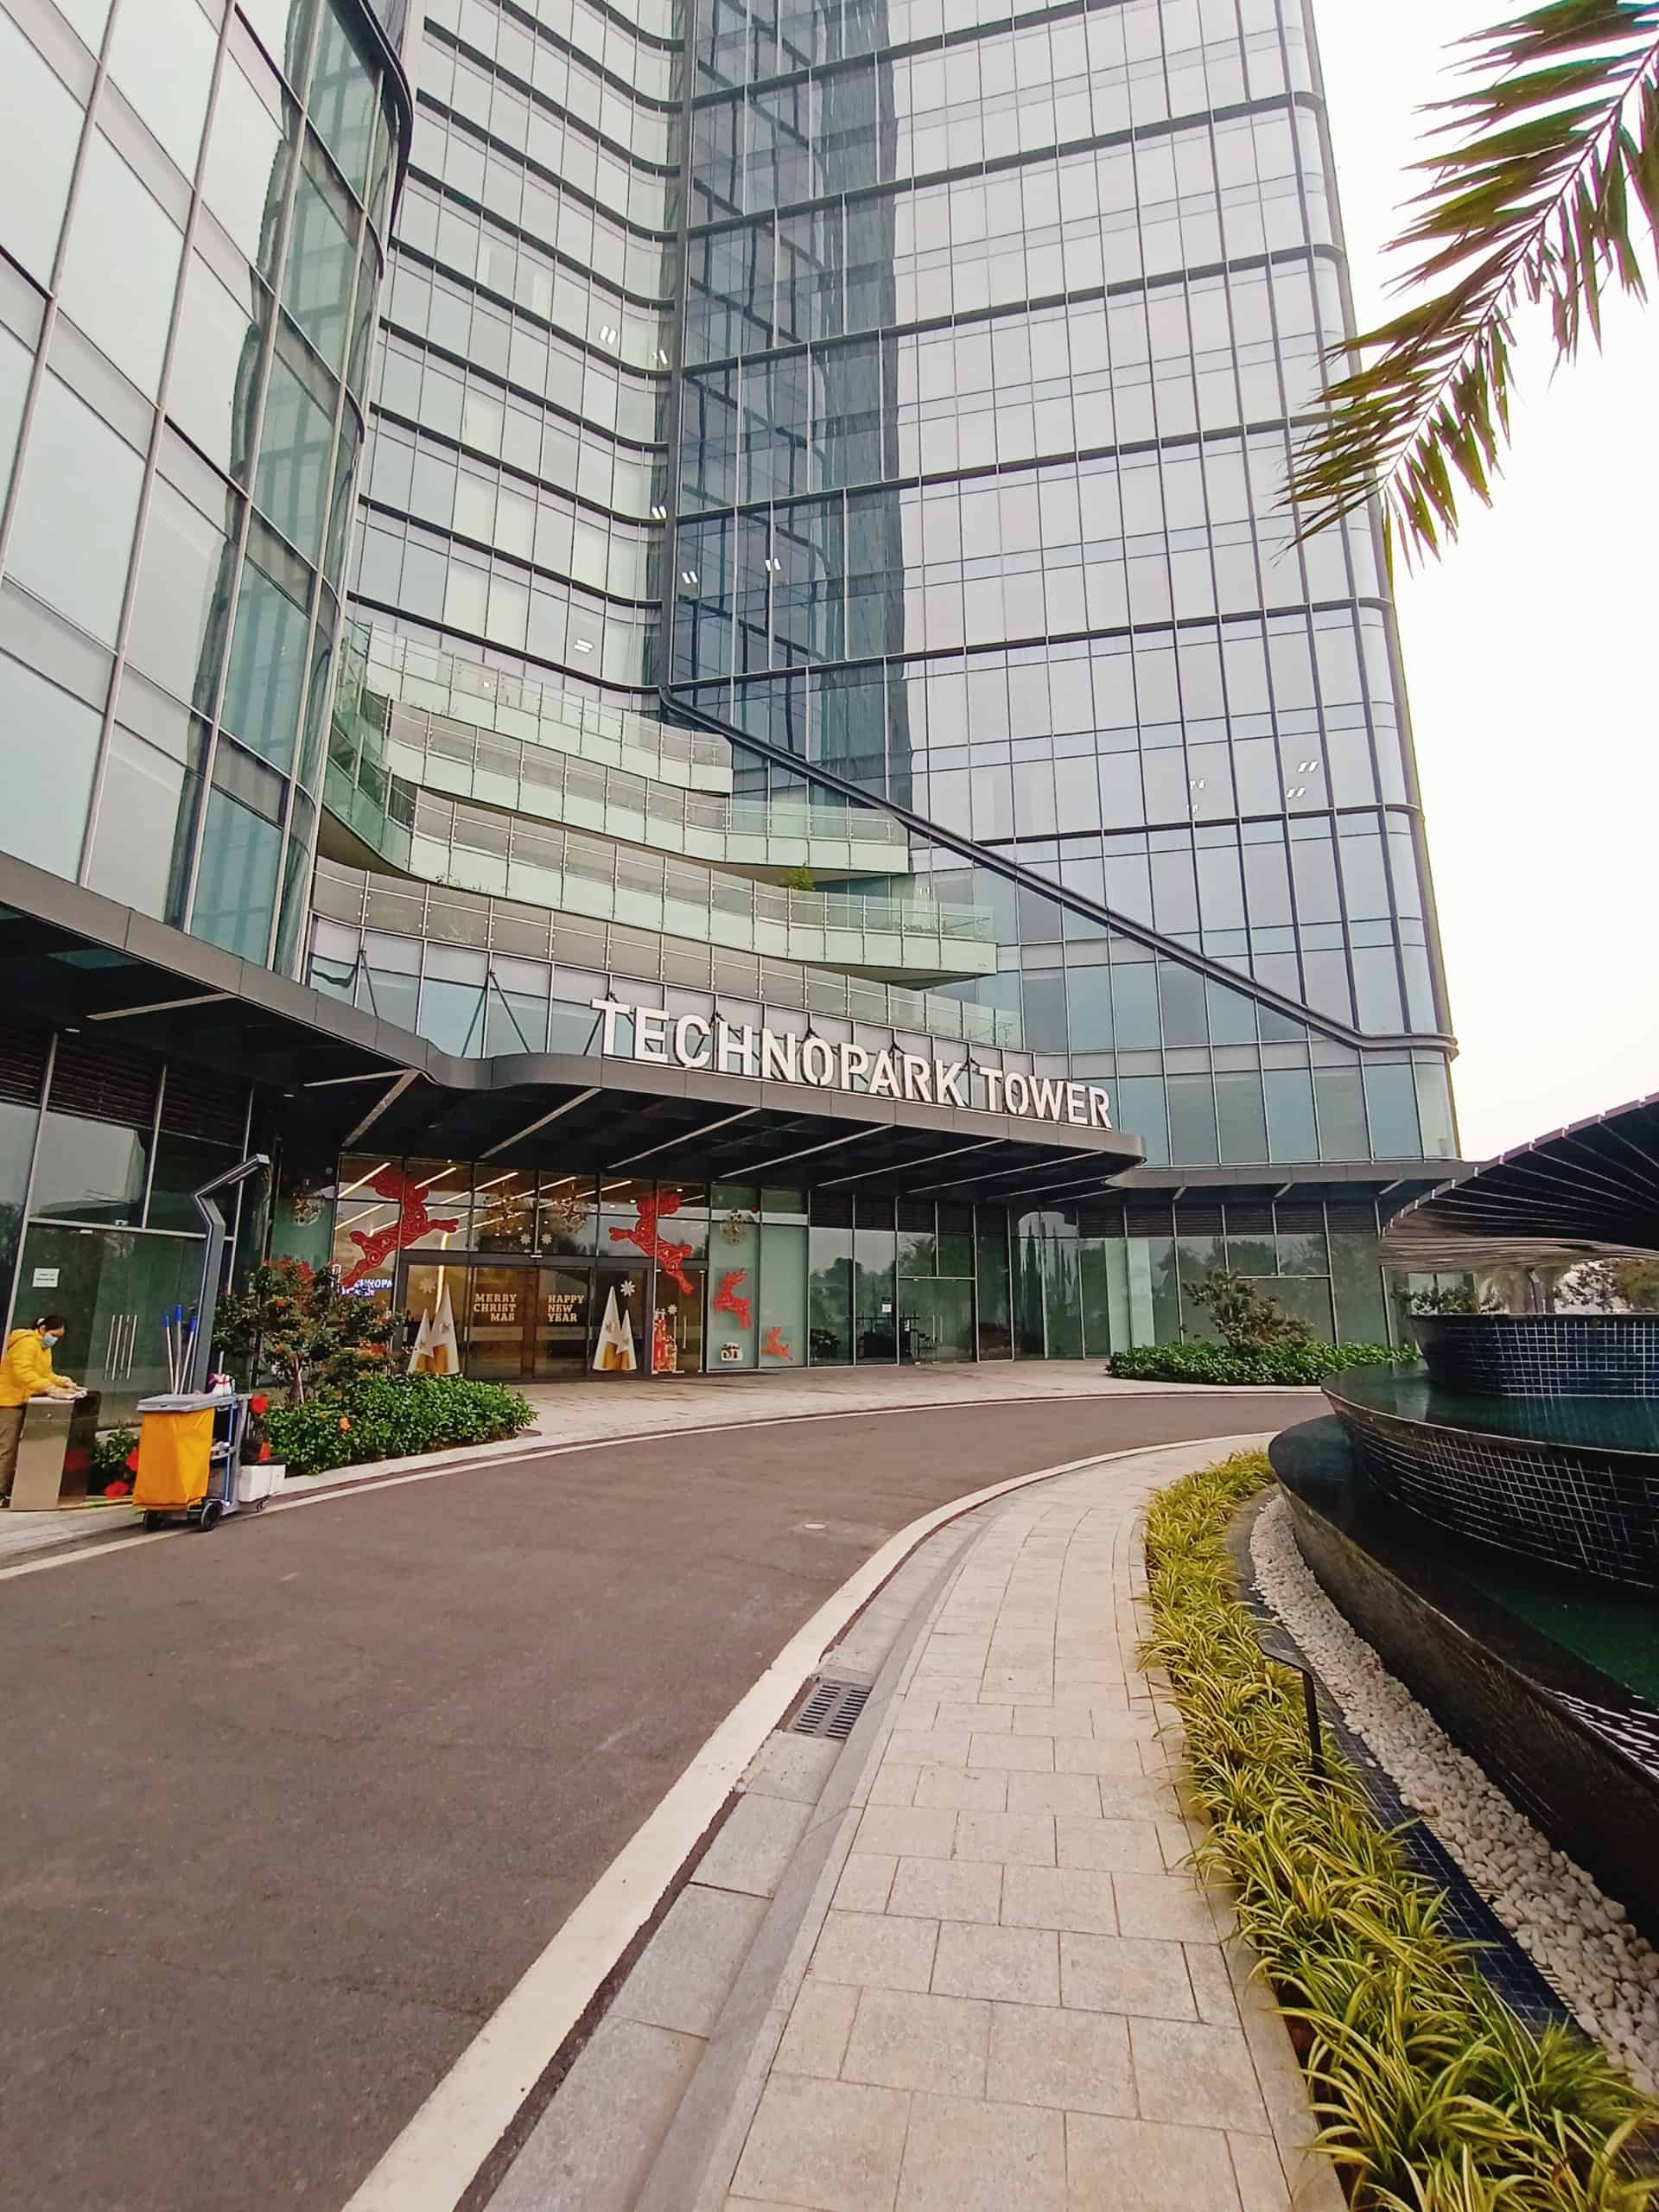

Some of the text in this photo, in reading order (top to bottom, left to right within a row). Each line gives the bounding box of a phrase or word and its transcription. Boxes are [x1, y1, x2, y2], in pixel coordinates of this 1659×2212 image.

[591, 998, 1113, 1128] TECHNOPARK TOWER
[475, 1294, 517, 1303] MERRY
[548, 1295, 584, 1304] HAPPY
[548, 1304, 574, 1313] NEW
[548, 1313, 577, 1322] YEAR
